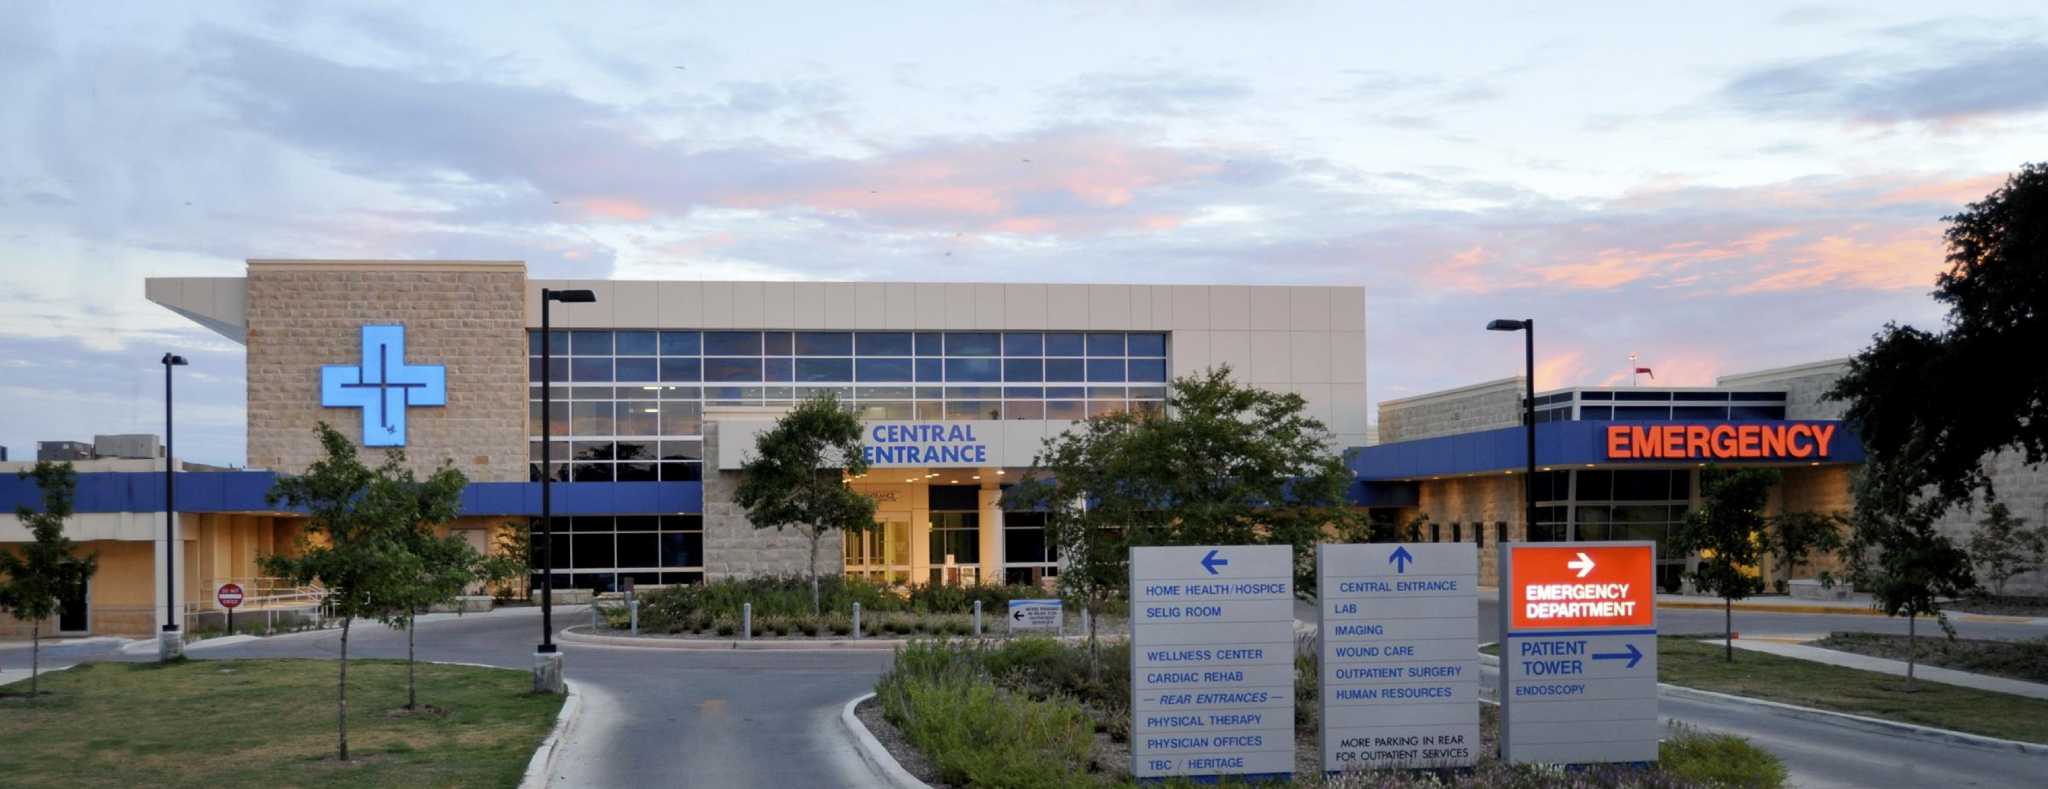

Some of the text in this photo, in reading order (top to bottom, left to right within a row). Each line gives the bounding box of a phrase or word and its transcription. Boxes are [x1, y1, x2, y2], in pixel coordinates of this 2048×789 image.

[873, 424, 976, 442] CENTRAL
[1608, 424, 1835, 458] EMERGENCY
[863, 445, 986, 464] ENTRANCE
[1146, 585, 1181, 595] HOME
[1340, 581, 1457, 592] CENTRAL ENTRANCE
[1526, 584, 1629, 600] EMERGENCY
[1147, 607, 1221, 618] SELIG ROOM
[1334, 604, 1357, 614] LAB
[1526, 602, 1636, 618] DEPARTMENT
[1335, 625, 1383, 636] IMAGING
[1336, 646, 1414, 657] WOUND CARE
[1522, 641, 1587, 656] PATIENT
[1147, 649, 1263, 661] WELLNESS CENTER
[1336, 667, 1462, 679] OUTPATIENT SURGERY
[1523, 661, 1582, 675] TOWER
[1147, 672, 1243, 683] CARDIAC REHAB
[1337, 688, 1452, 700] HUMAN RESOURCES
[1516, 685, 1585, 696] ENDOSCOPY
[1160, 692, 1268, 705] REAR ENTRANCES
[1147, 714, 1262, 727] PHYSICAL THERAPY
[1148, 736, 1262, 749] PHYSICIAN OFFICES
[1340, 735, 1464, 747] MORE PARKING IN REAR
[1336, 748, 1469, 761] FOR OUTPATIENT SERVICES
[1149, 760, 1172, 771] TBC
[1188, 758, 1243, 769] HERITAGE
